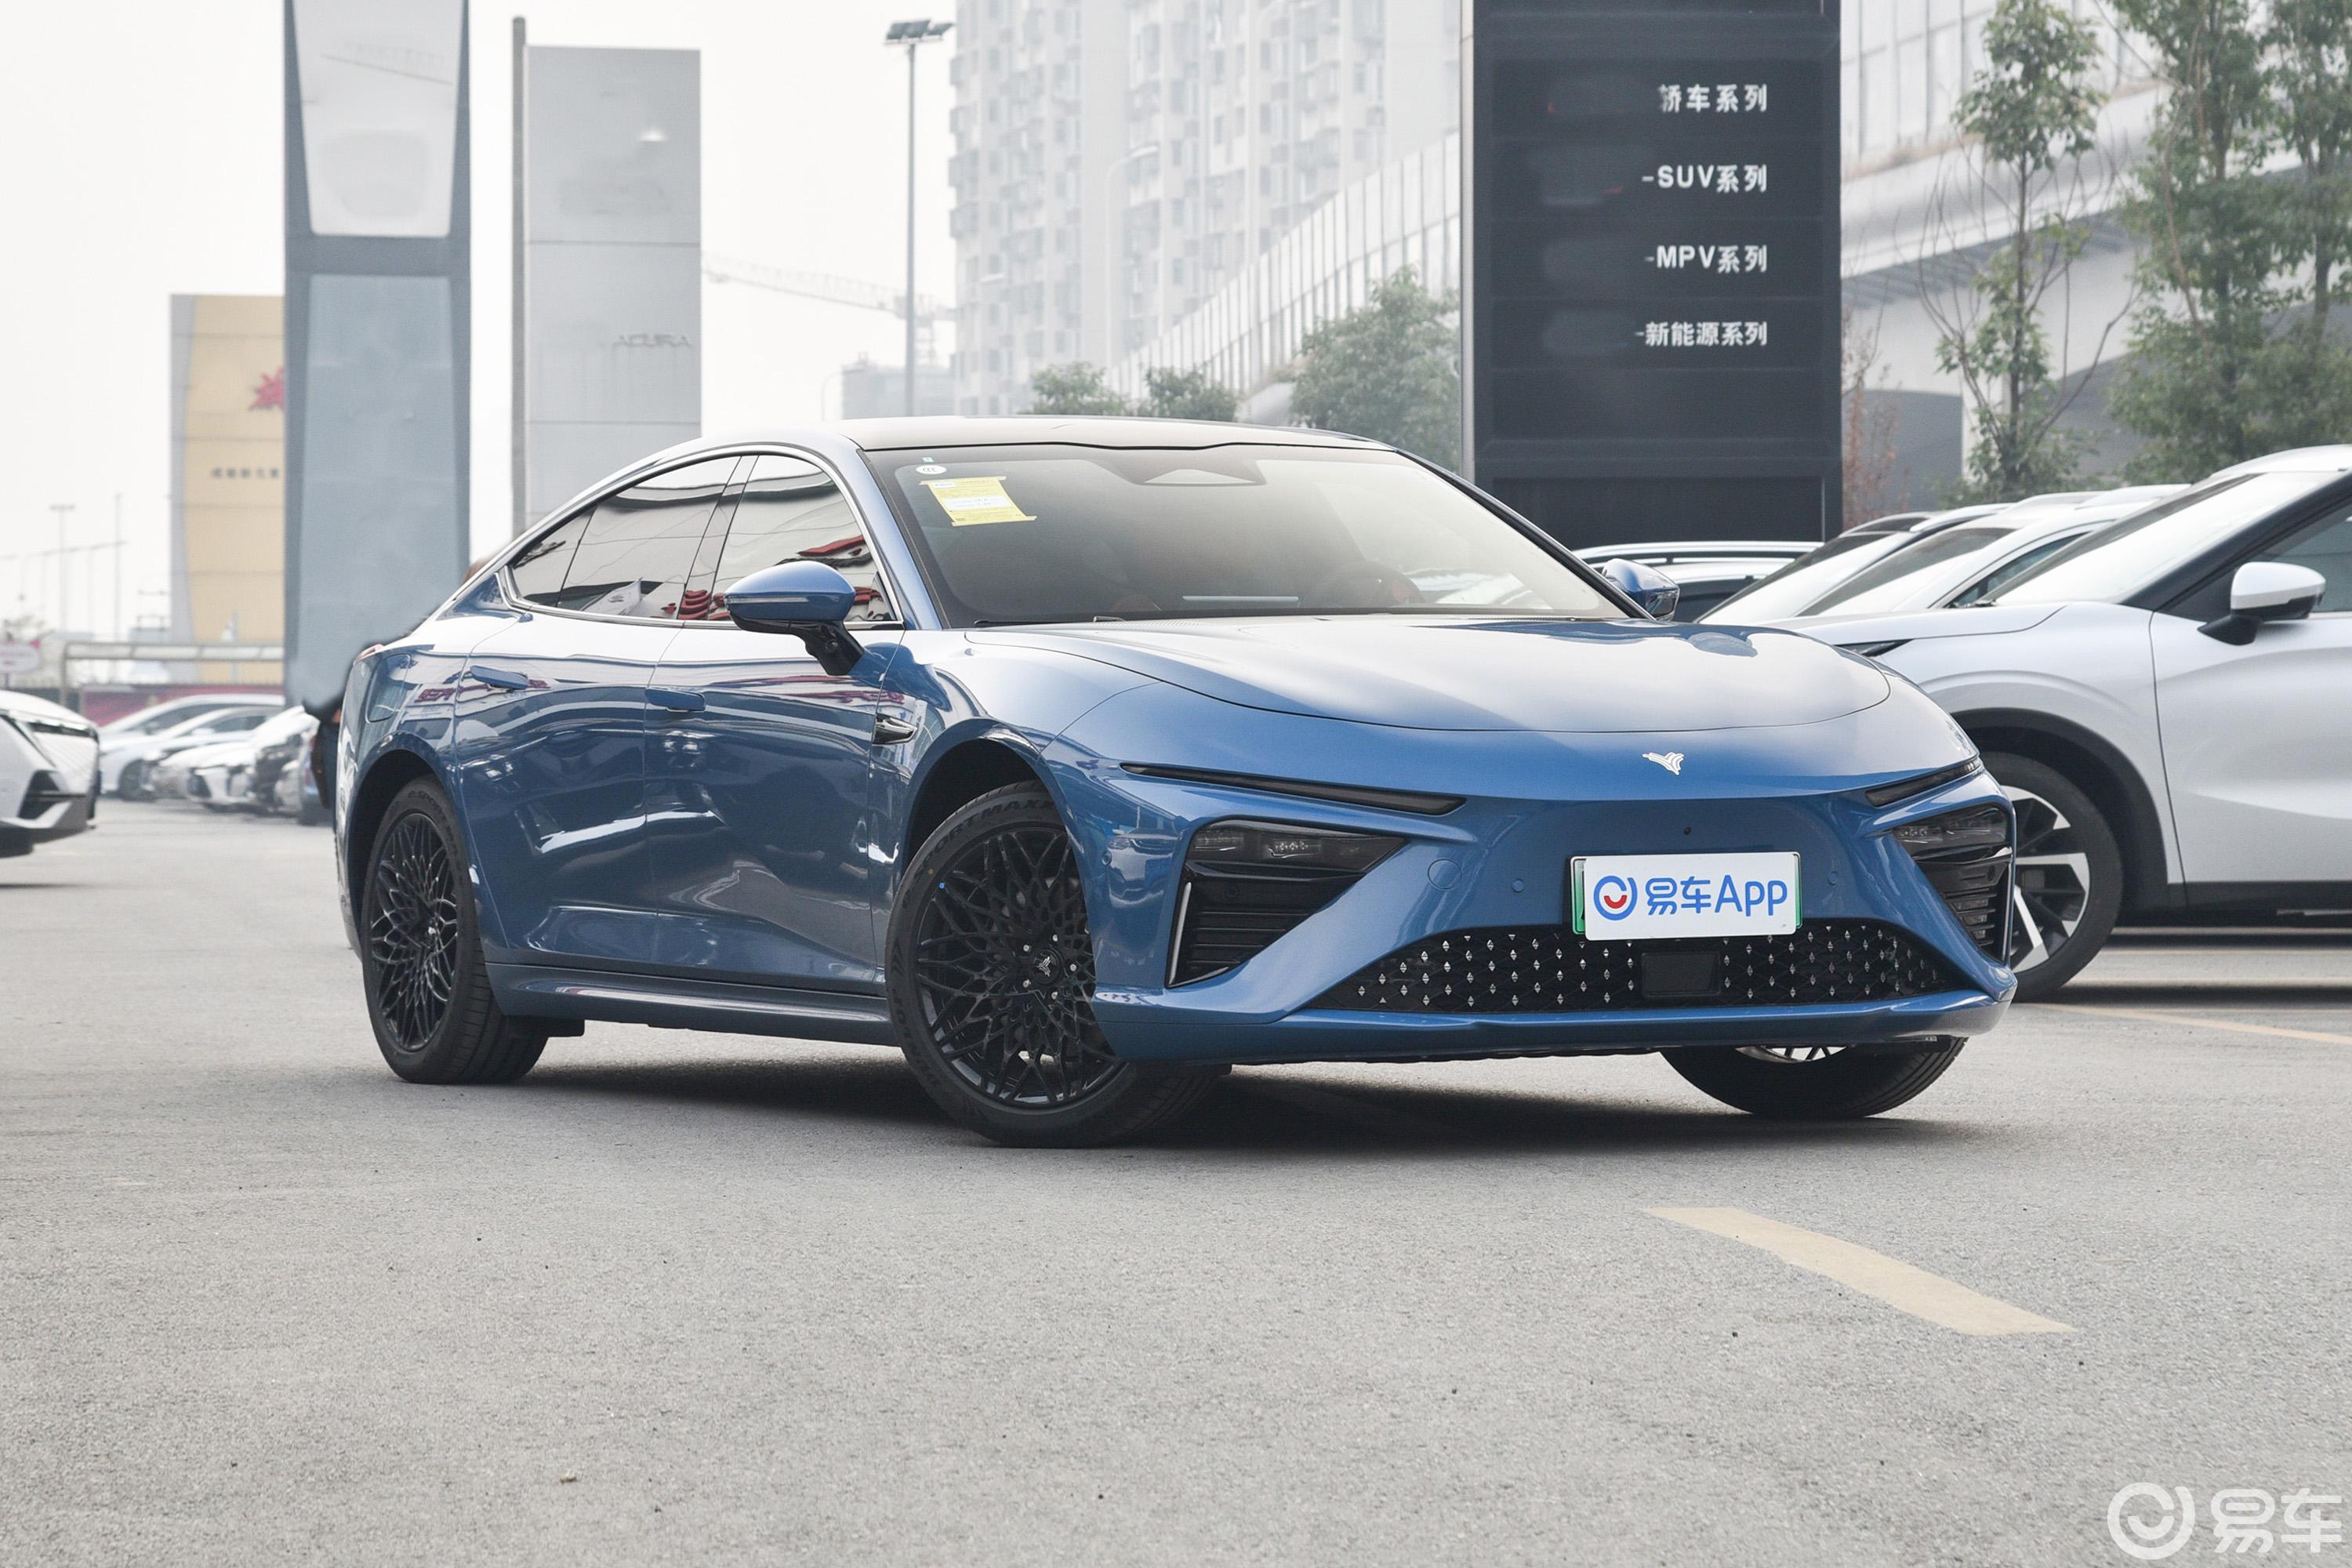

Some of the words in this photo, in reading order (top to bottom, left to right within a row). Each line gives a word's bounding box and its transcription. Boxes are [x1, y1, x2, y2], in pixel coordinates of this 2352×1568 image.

[1658, 83, 1767, 113] 轿车系列
[1645, 874, 1788, 917] 易车App
